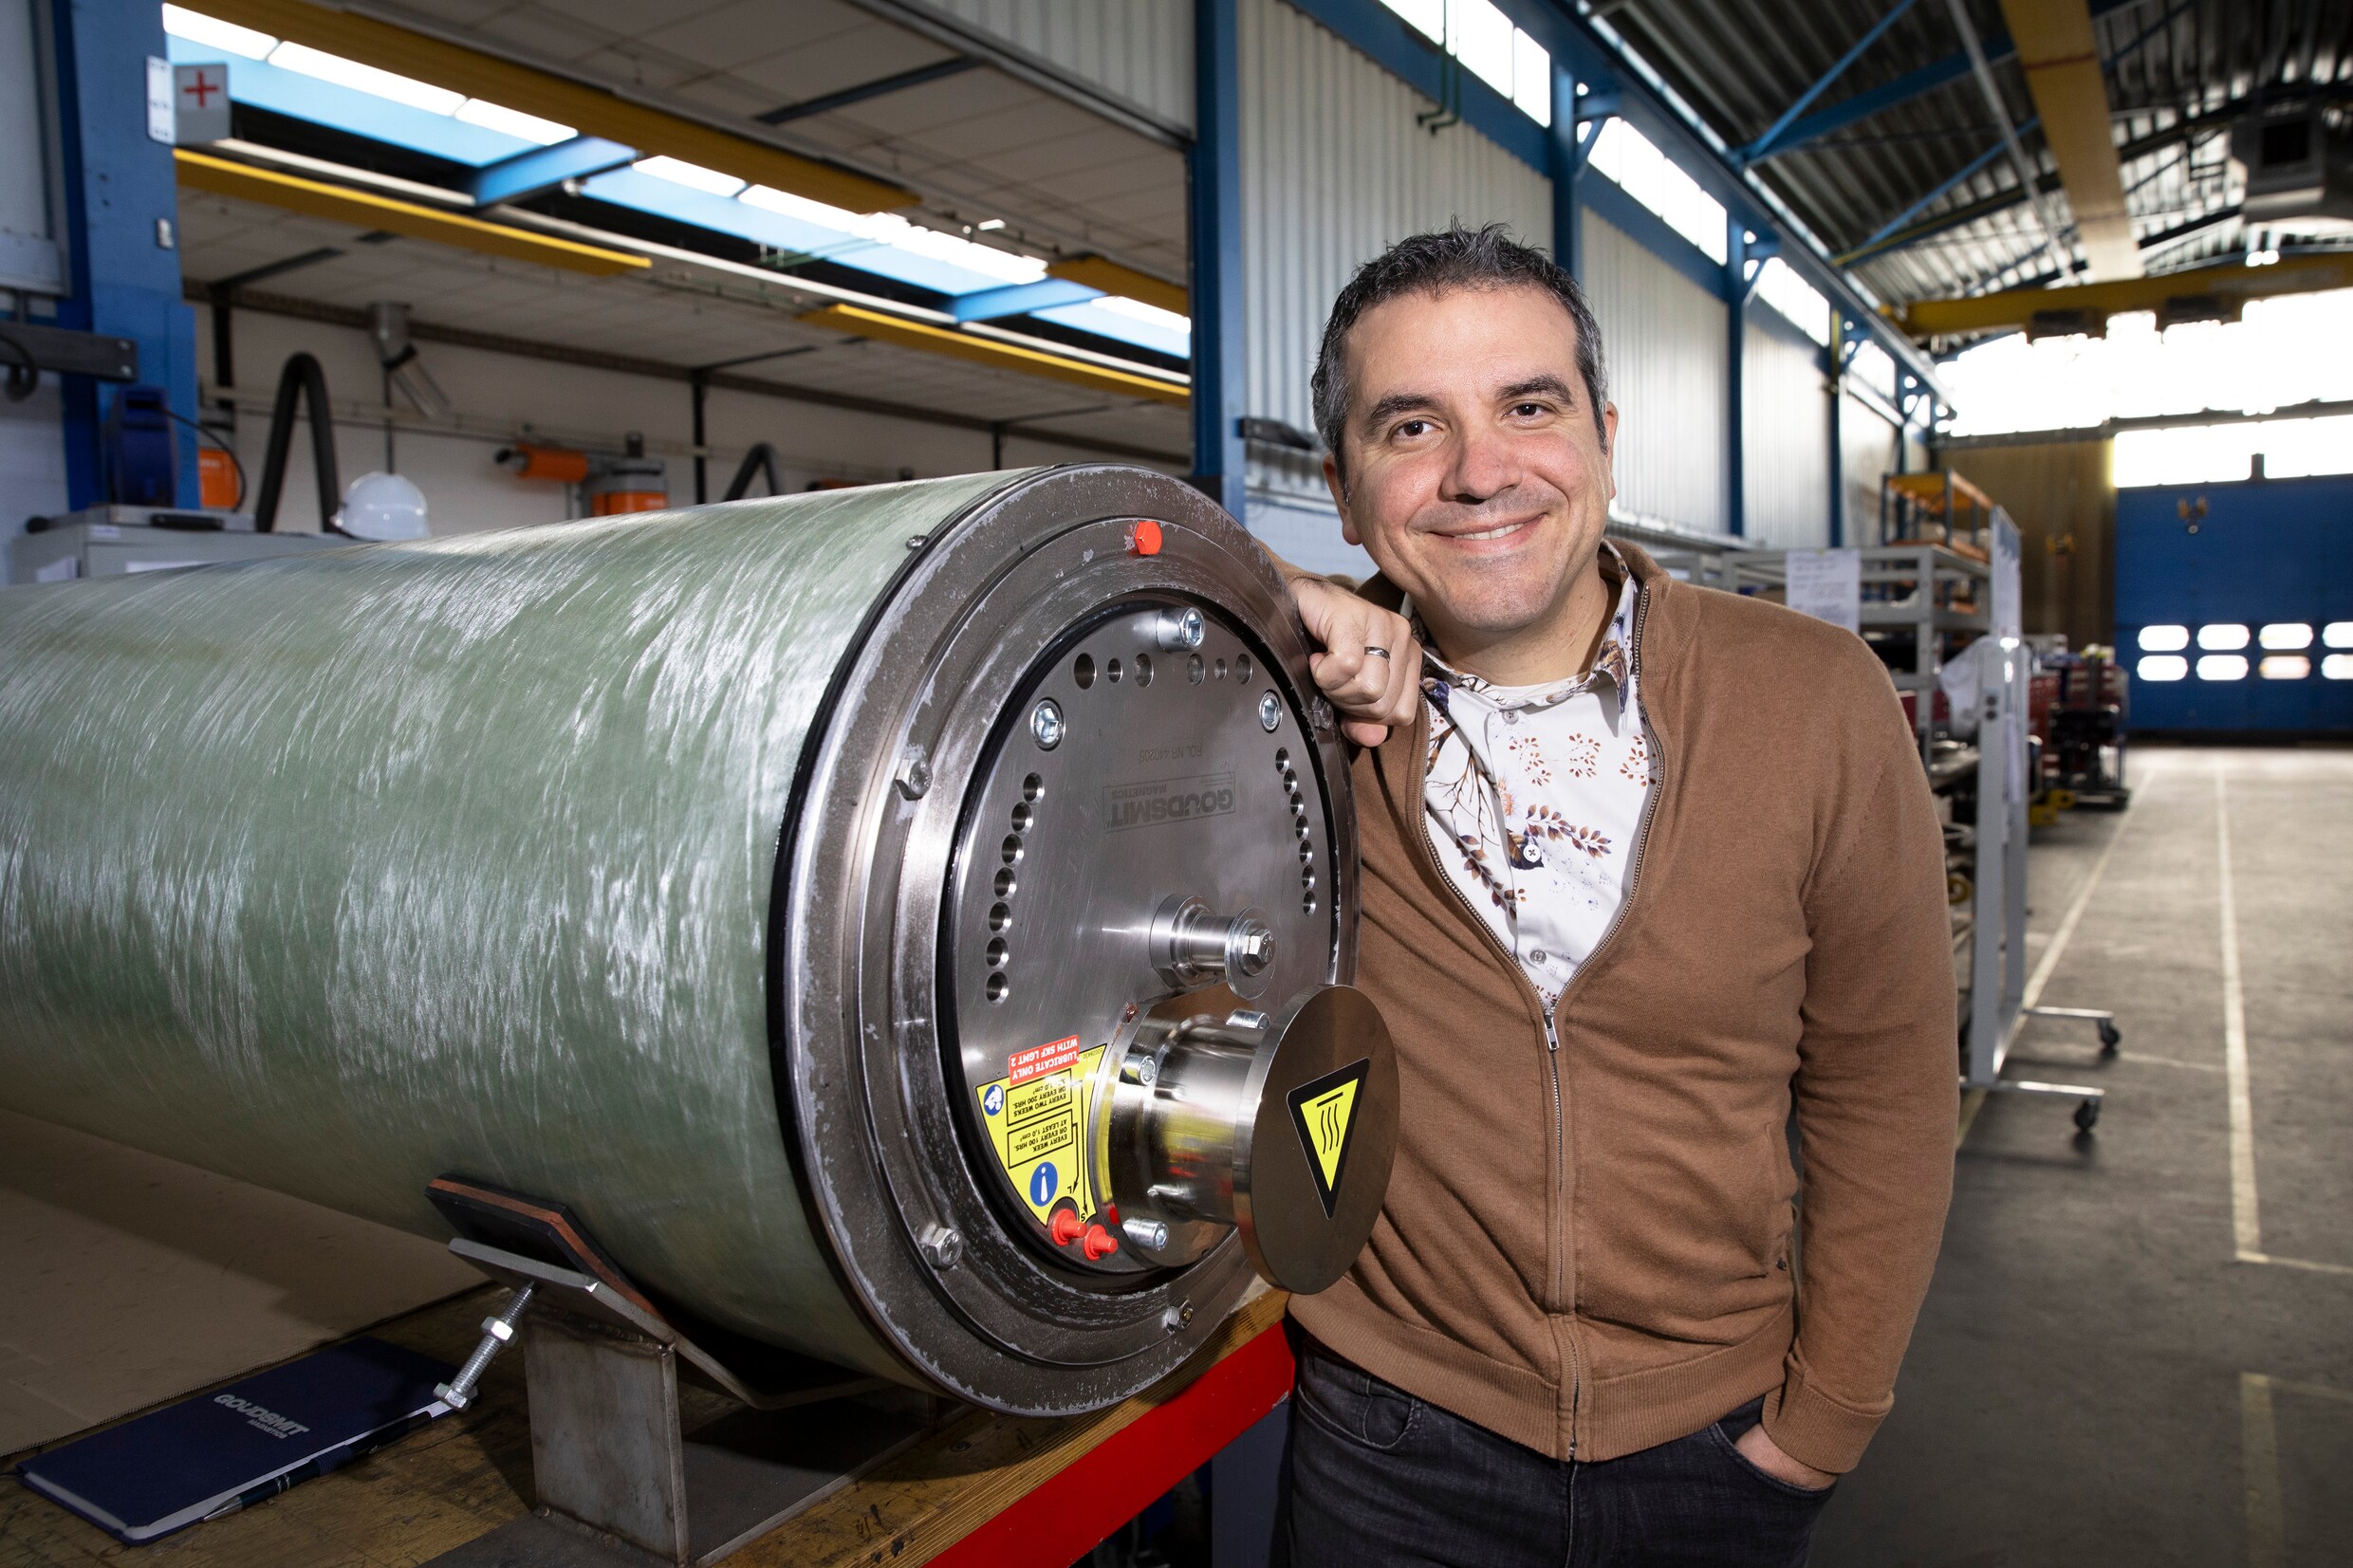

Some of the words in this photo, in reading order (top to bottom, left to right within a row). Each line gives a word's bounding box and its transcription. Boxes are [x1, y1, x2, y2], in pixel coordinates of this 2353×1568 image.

[1112, 784, 1167, 799] MAGNETICS
[1108, 788, 1233, 828] GOUDSMIT
[1041, 1044, 1056, 1058] SKF
[1057, 1038, 1078, 1053] WITH
[1010, 1058, 1016, 1067] 2
[1018, 1050, 1040, 1064] LGMT
[1035, 1050, 1078, 1073] LUBRICATE
[1011, 1065, 1034, 1080] ONLY
[1028, 1096, 1038, 1104] 200
[1039, 1089, 1057, 1100] EVERY
[1048, 1093, 1066, 1104] EVERY
[1012, 1099, 1027, 1110] HRS.
[1035, 1100, 1047, 1110] TWO
[1013, 1105, 1033, 1117] WEEKS
[1042, 1122, 1060, 1133] LEAST
[1060, 1118, 1067, 1127] AT
[1032, 1129, 1041, 1137] 1,0
[1040, 1130, 1059, 1141] EVERY
[1049, 1134, 1067, 1145] EVERY
[1014, 1141, 1028, 1152] HRS.
[1032, 1141, 1048, 1153] WEEK
[213, 1393, 310, 1436] GOUDSMIT
